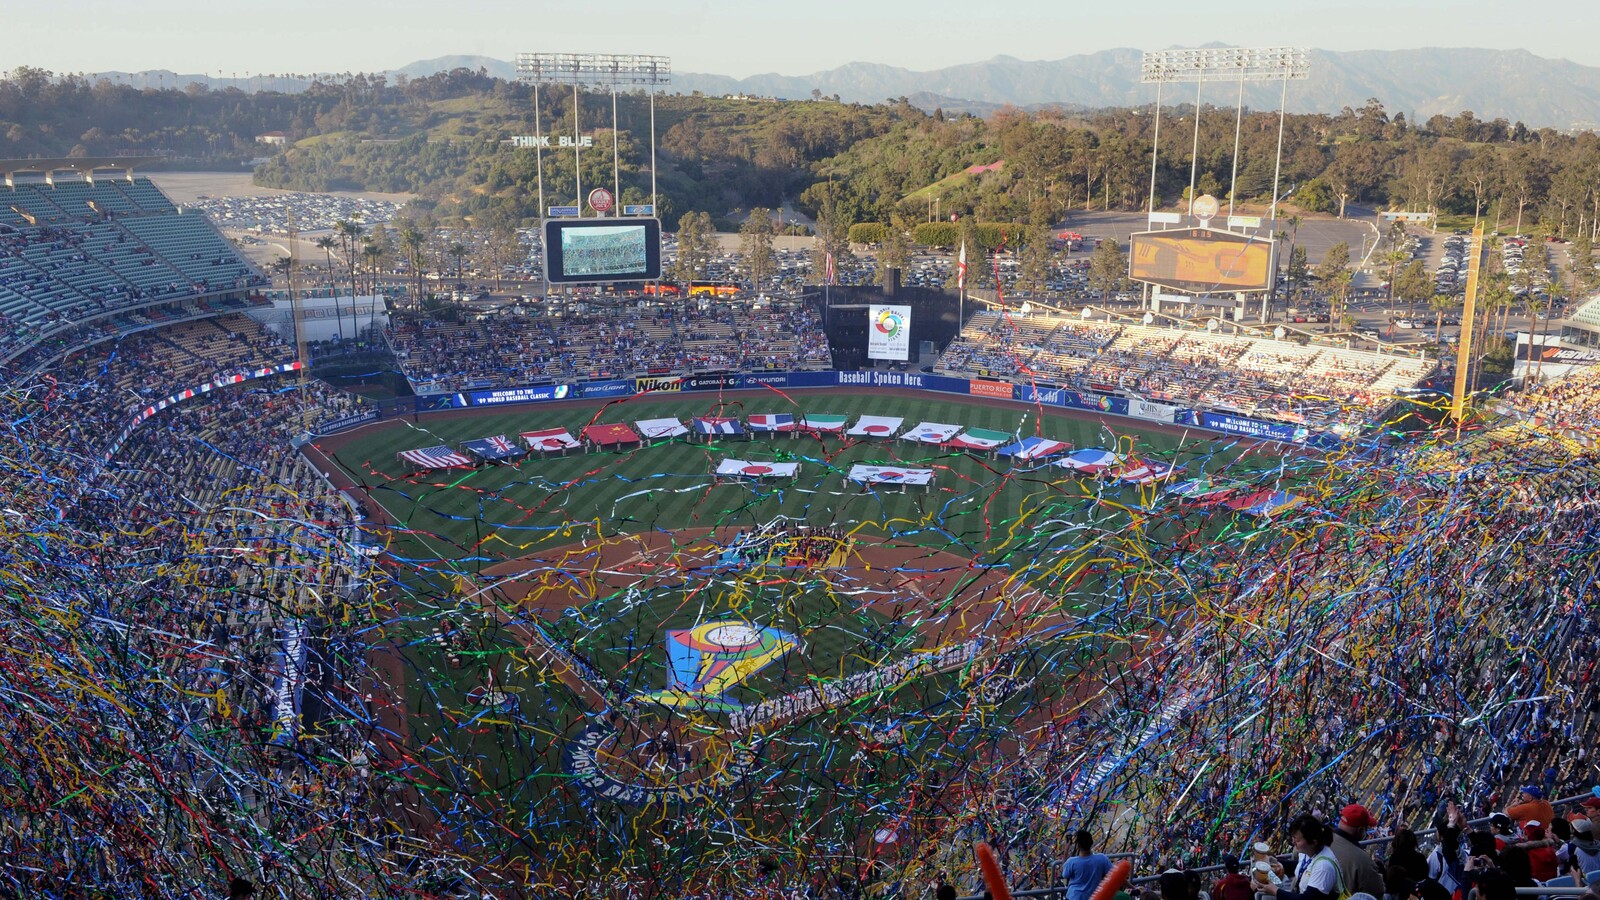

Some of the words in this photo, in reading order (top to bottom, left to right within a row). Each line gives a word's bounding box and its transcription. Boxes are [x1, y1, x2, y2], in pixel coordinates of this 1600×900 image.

[511, 136, 550, 147] THINK
[558, 136, 593, 147] BLUE
[839, 371, 871, 383] Baseball
[873, 371, 901, 386] Spoken
[904, 372, 923, 387] Here.
[637, 378, 680, 392] Nikon
[970, 383, 995, 392] PUERTO
[506, 394, 529, 402] BASEBALL
[1219, 423, 1238, 431] WORLD
